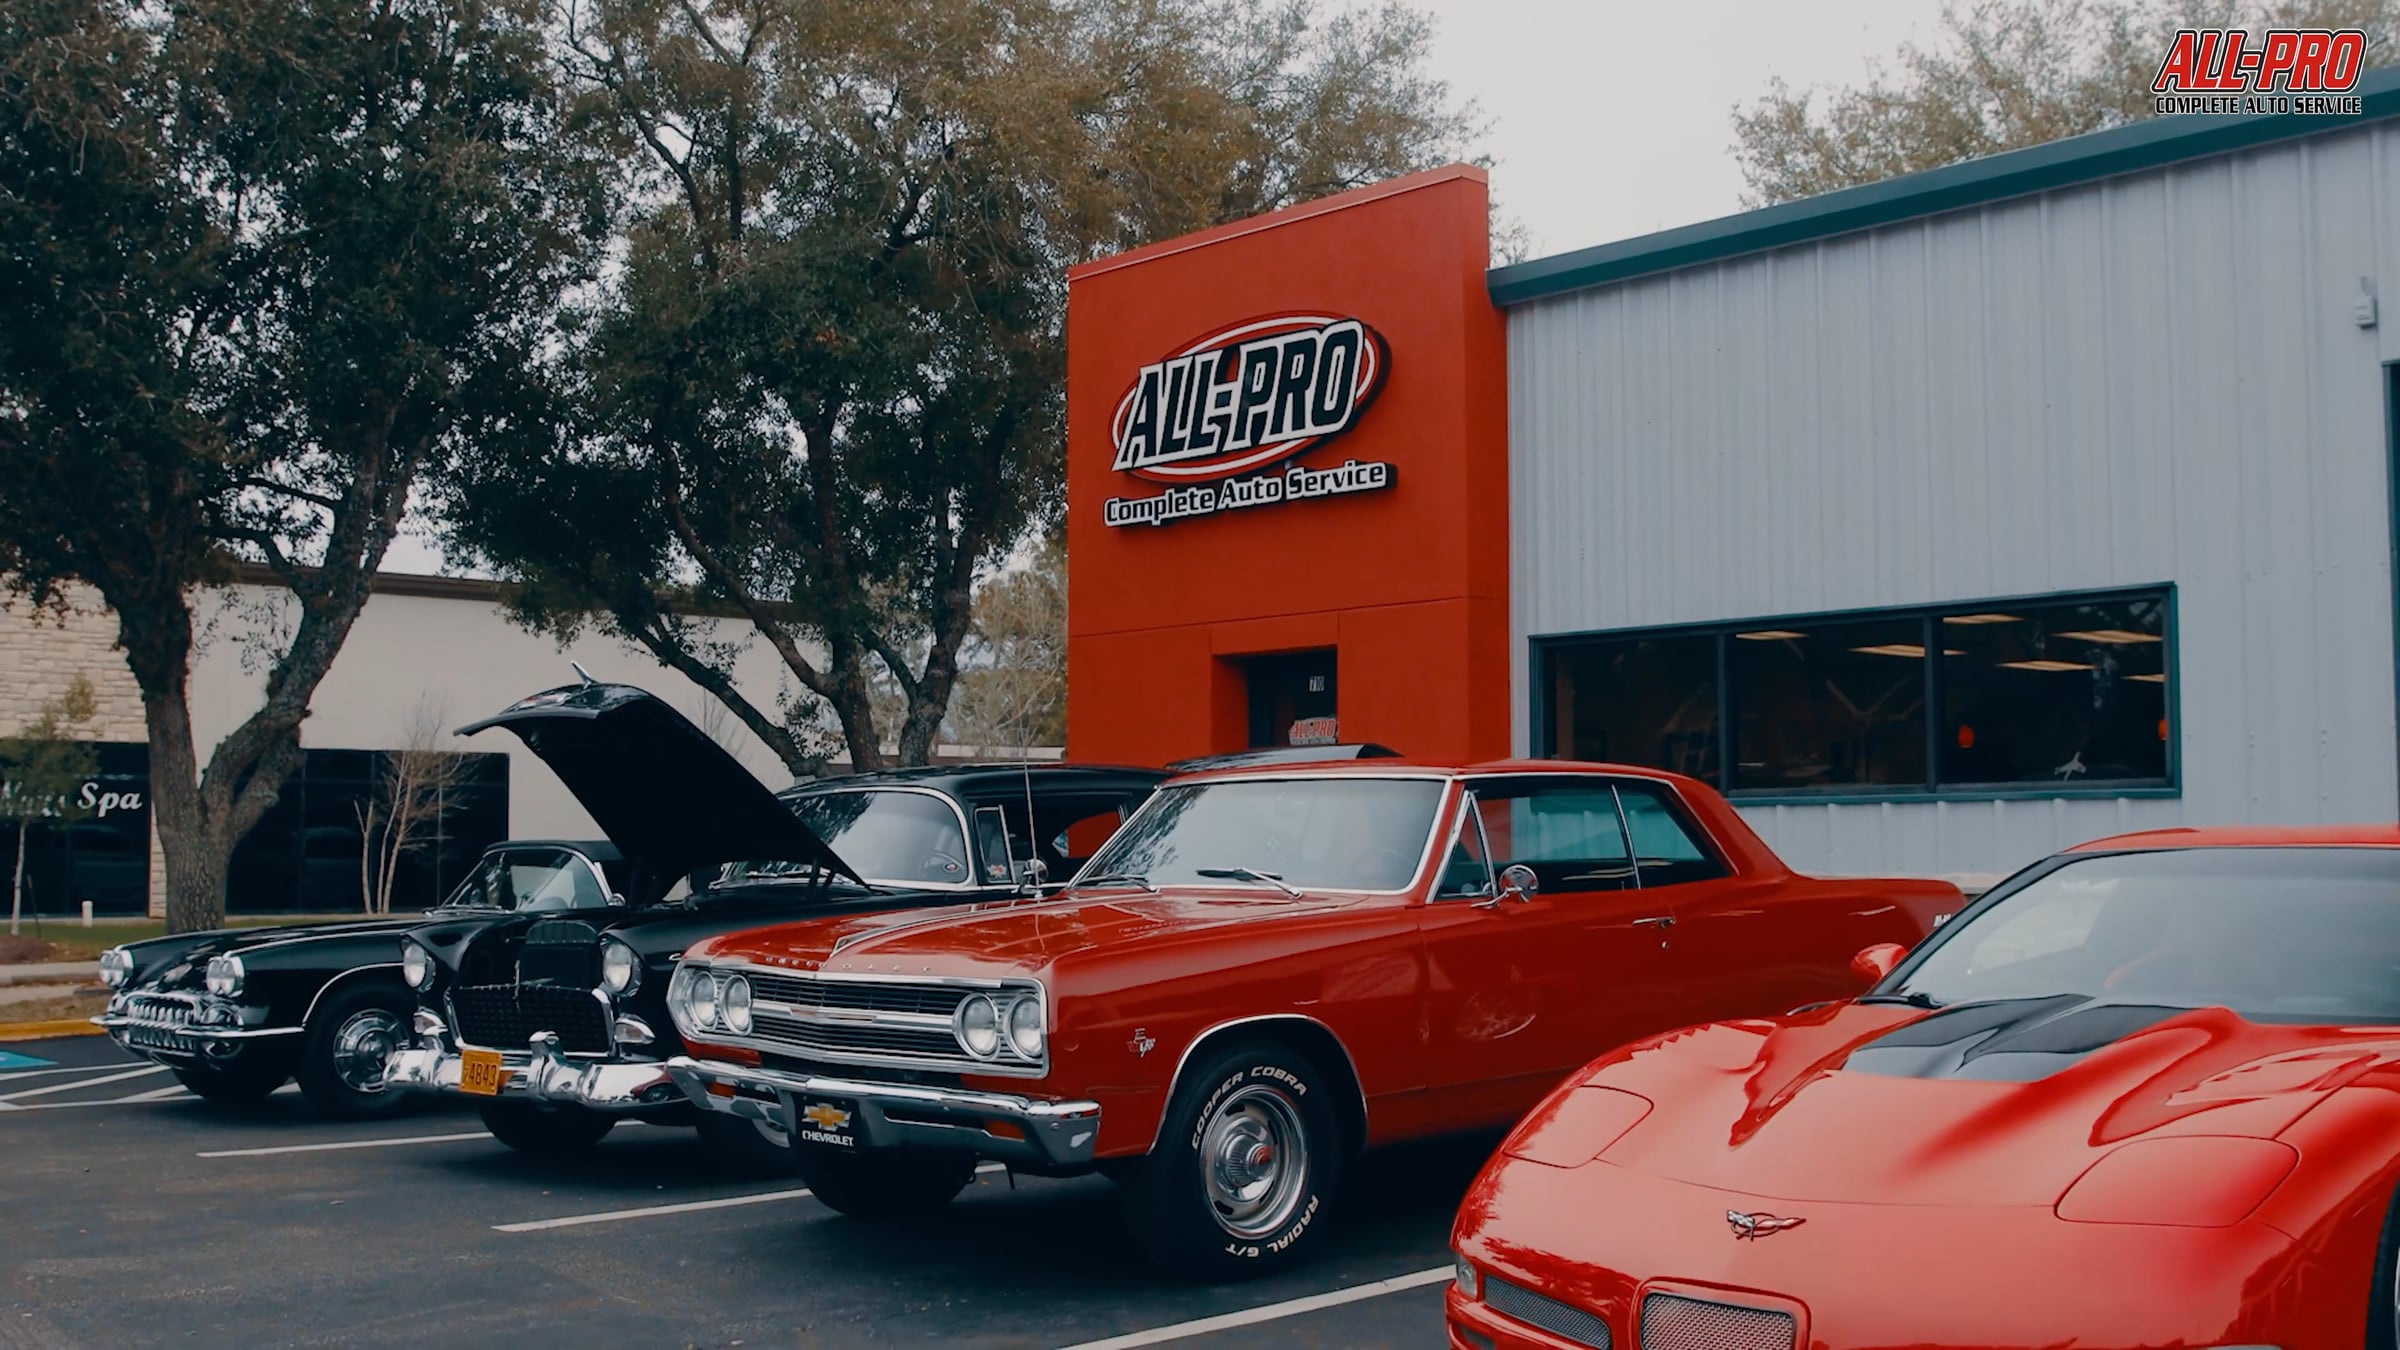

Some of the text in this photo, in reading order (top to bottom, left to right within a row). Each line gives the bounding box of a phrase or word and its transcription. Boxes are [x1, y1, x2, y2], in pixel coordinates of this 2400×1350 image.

[1112, 318, 1364, 471] ALL-PRO
[1105, 461, 1386, 526] Complete Auto Service
[77, 782, 142, 817] Spa
[469, 1062, 498, 1086] 4843
[802, 1130, 854, 1147] CHEVROLET
[1191, 1066, 1307, 1150] COOPER COBRA
[1225, 1194, 1319, 1257] RADIAL G/T
